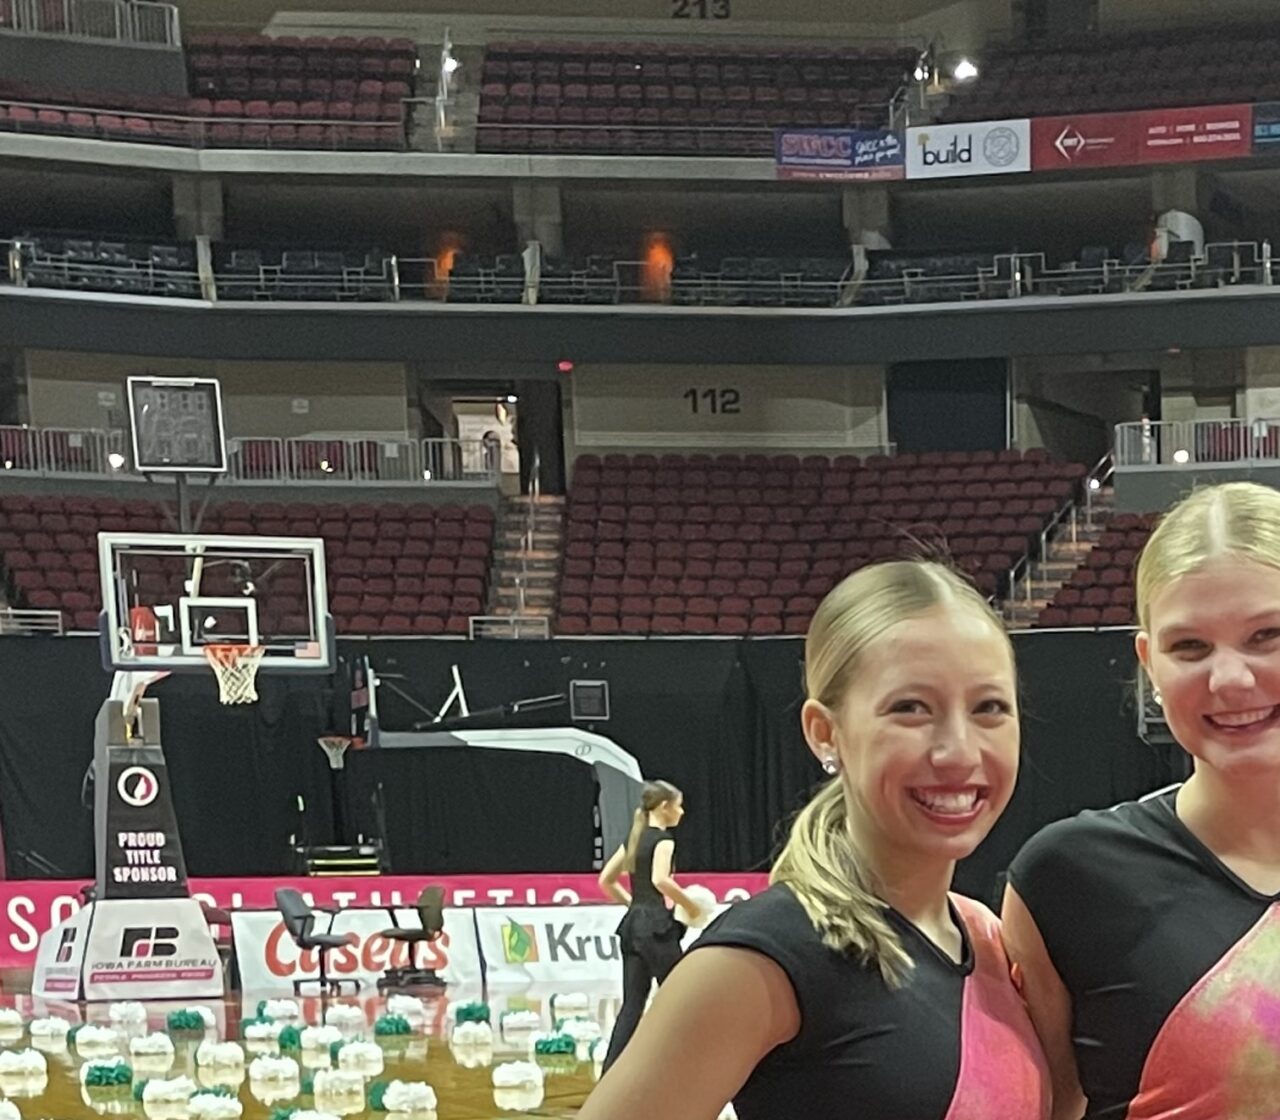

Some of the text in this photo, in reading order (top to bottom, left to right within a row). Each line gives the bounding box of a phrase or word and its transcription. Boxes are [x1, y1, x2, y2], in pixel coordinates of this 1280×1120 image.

[671, 0, 731, 19] 213
[922, 133, 972, 166] build
[683, 388, 741, 414] 112
[117, 831, 166, 848] PROUD
[125, 849, 161, 864] TITLE
[112, 866, 177, 883] SPONSOR
[127, 960, 163, 969] FARM
[165, 957, 217, 968] BUREAU
